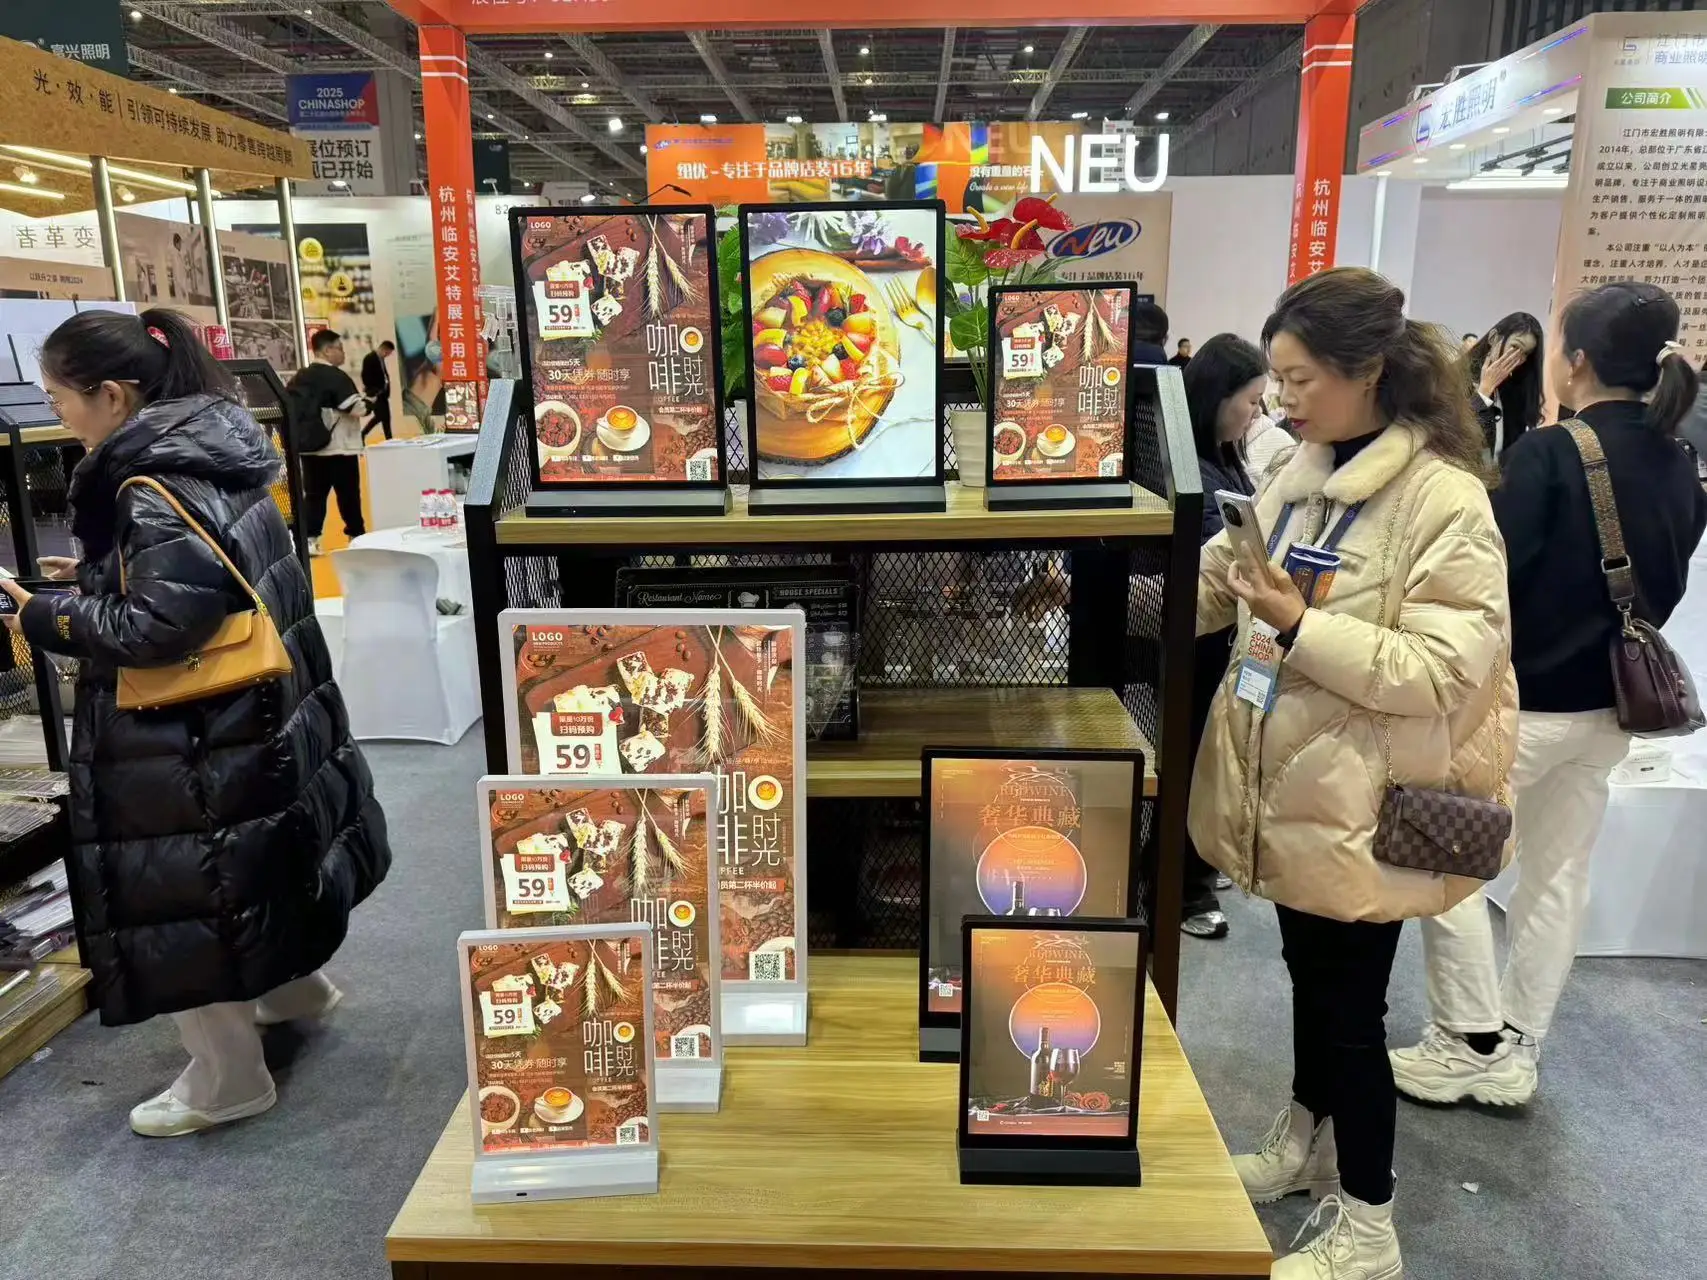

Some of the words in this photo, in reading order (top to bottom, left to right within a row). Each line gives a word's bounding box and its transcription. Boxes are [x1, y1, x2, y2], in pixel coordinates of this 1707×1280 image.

[317, 88, 343, 98] 2025
[1621, 92, 1672, 105] 公司简介
[299, 99, 365, 109] CHINASHOP
[1623, 128, 1707, 138] 江门市宏胜照明有限
[1031, 133, 1169, 193] NEU
[1595, 178, 1707, 187] 明品牌，专注于商业照明设
[530, 221, 551, 229] LOGO
[438, 186, 468, 377] 杭州临安艾特展示用品
[549, 304, 573, 324] 59
[1011, 353, 1029, 367] 59
[780, 588, 803, 596] HOUSE
[804, 587, 838, 596] SPECIALS
[532, 632, 563, 642] LOGO
[1251, 630, 1271, 645] 2024
[1248, 647, 1270, 662] SHOP
[1249, 639, 1274, 656] CHINA
[556, 744, 591, 769] 59
[752, 813, 781, 867] 时光
[518, 878, 546, 898] 59
[493, 1008, 516, 1025] 59
